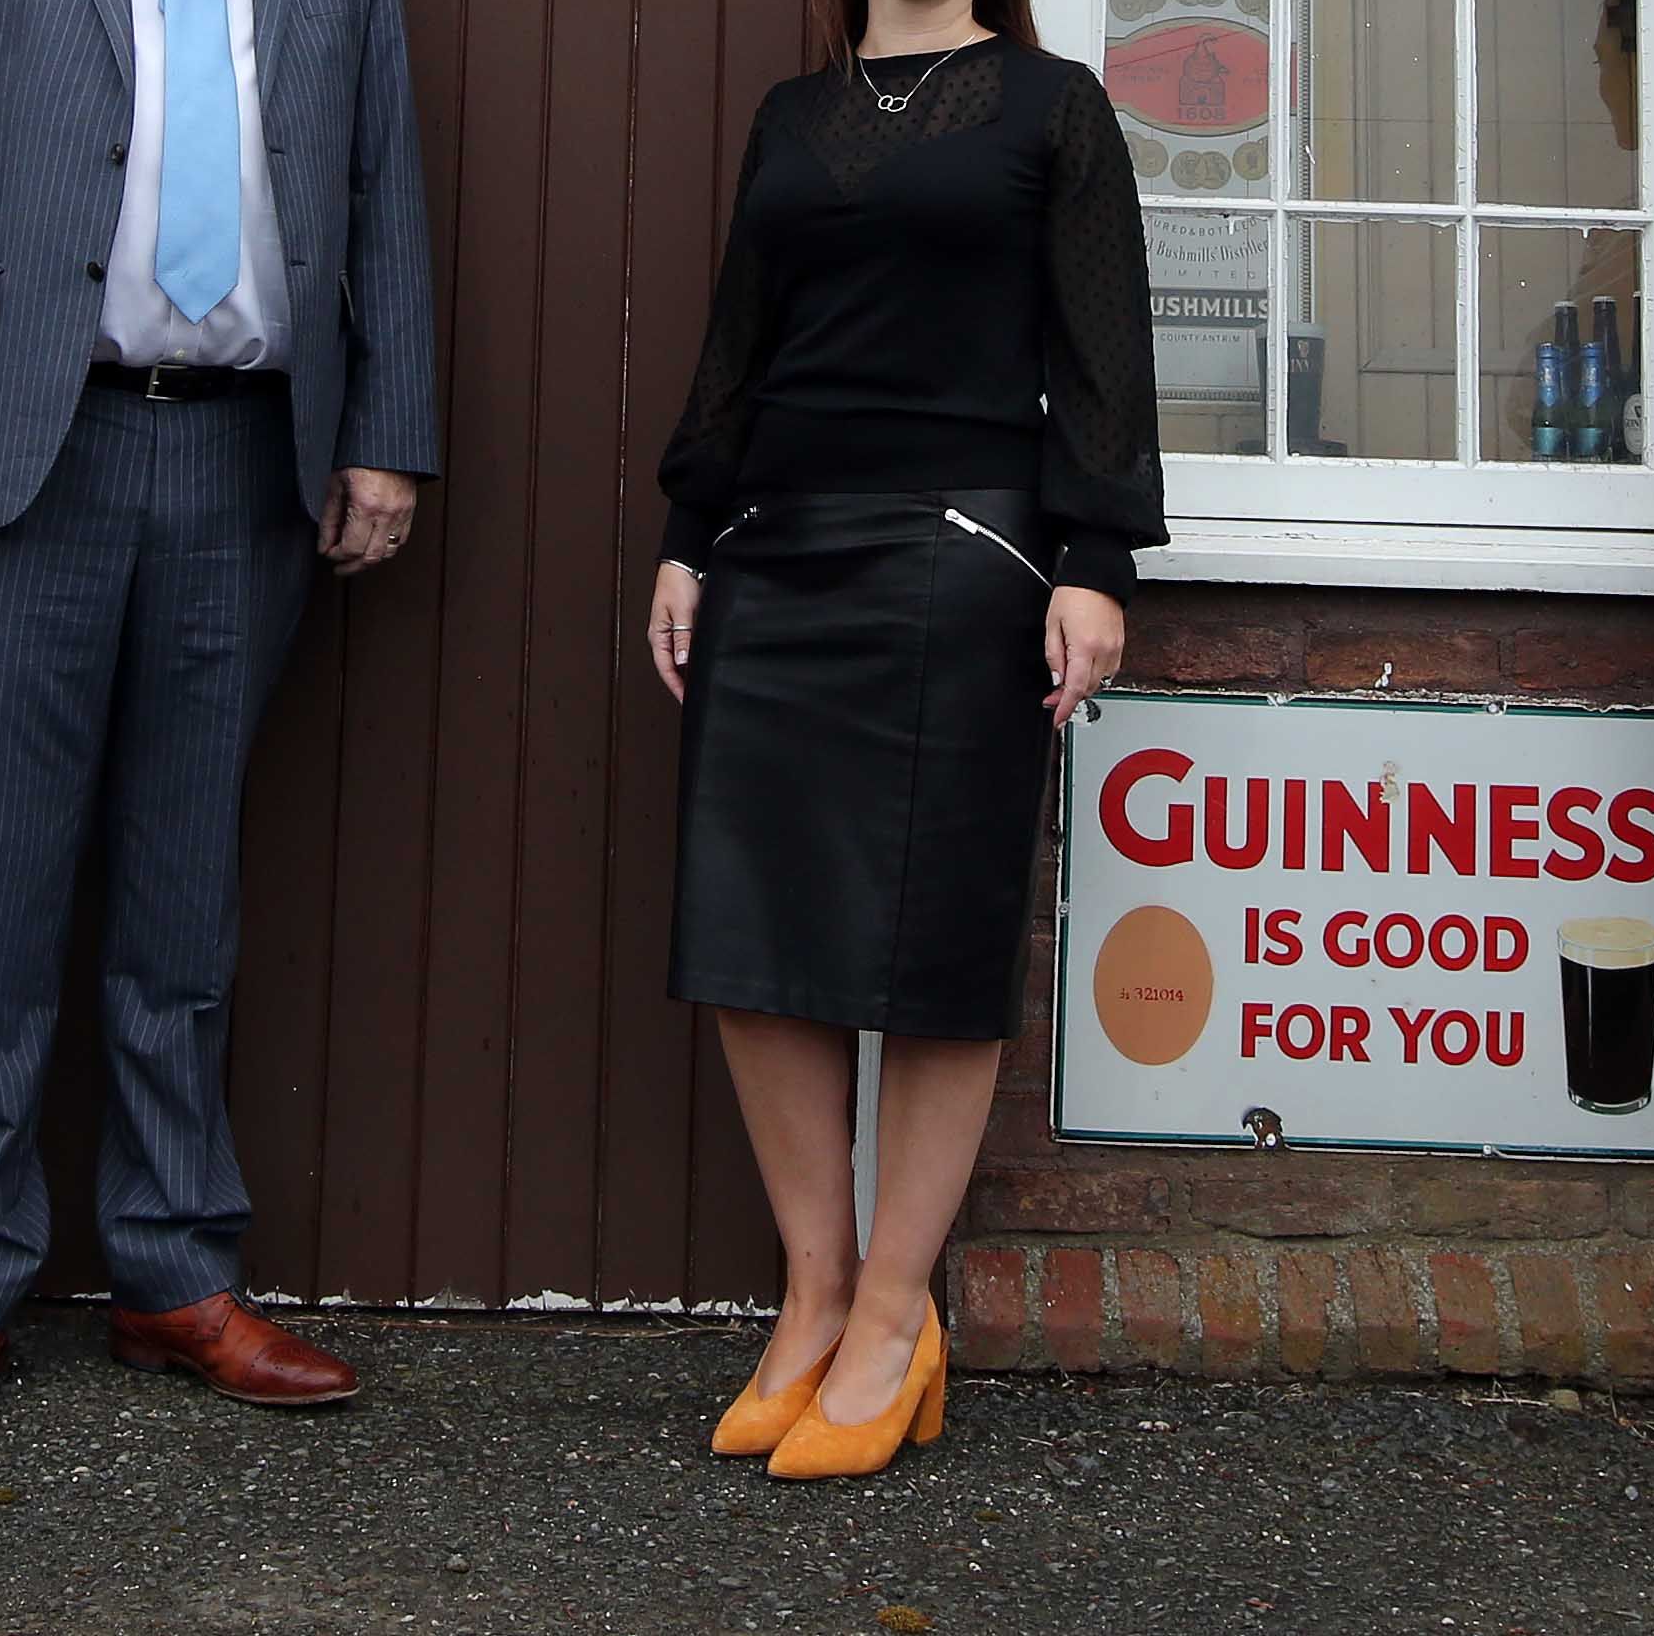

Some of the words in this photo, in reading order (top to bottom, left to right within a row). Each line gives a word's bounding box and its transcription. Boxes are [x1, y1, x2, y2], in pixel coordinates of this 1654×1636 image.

[1164, 270, 1256, 279] IMITED
[1151, 296, 1268, 319] USHMILLS
[1244, 907, 1303, 965] IS
[1323, 910, 1529, 972] GOOD
[1239, 1002, 1371, 1062] FOR
[1387, 1008, 1525, 1067] YOU
